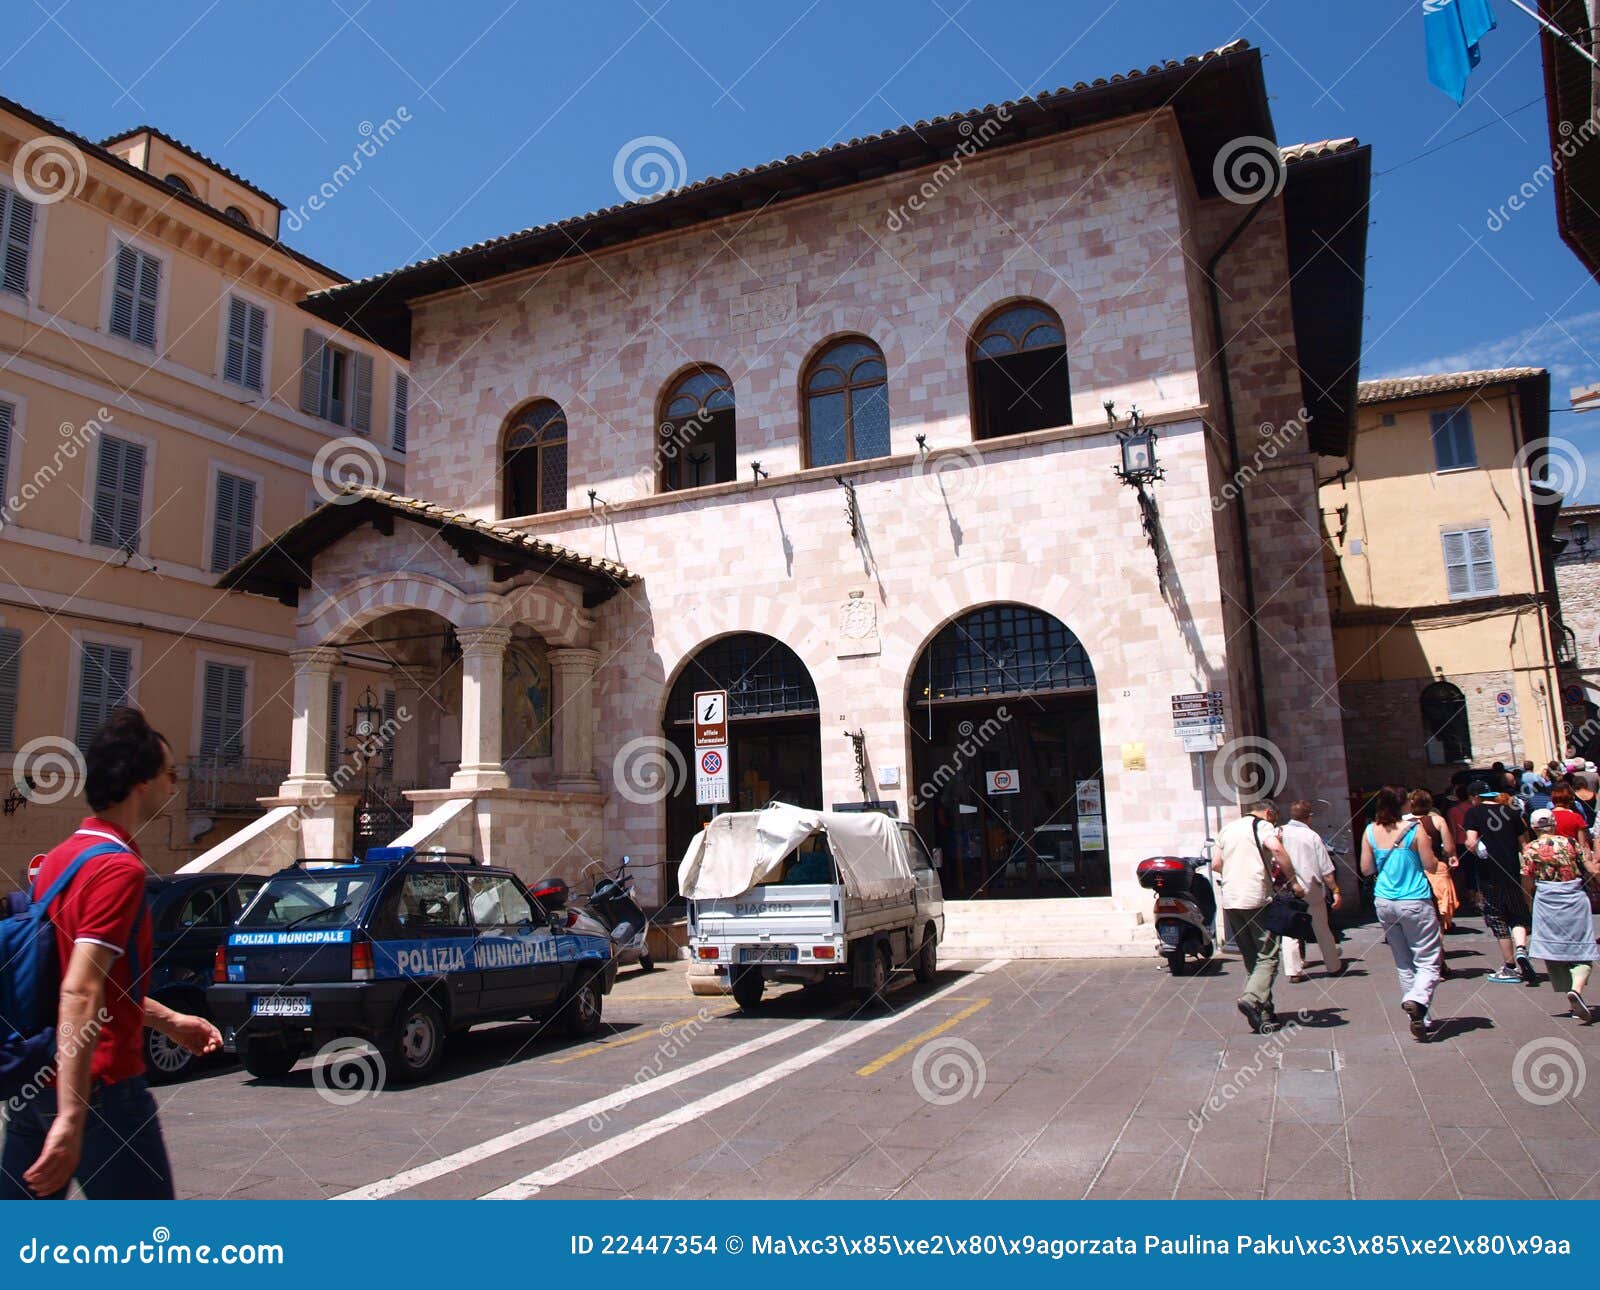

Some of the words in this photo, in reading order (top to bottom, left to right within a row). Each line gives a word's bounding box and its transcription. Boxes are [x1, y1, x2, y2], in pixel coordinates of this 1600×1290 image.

[736, 903, 793, 913] PIAGGIO
[235, 934, 274, 945] POLIZIA
[277, 931, 344, 944] MUNICIPALE
[397, 947, 466, 975] POLIZIA
[474, 941, 558, 968] MUNICIPALE
